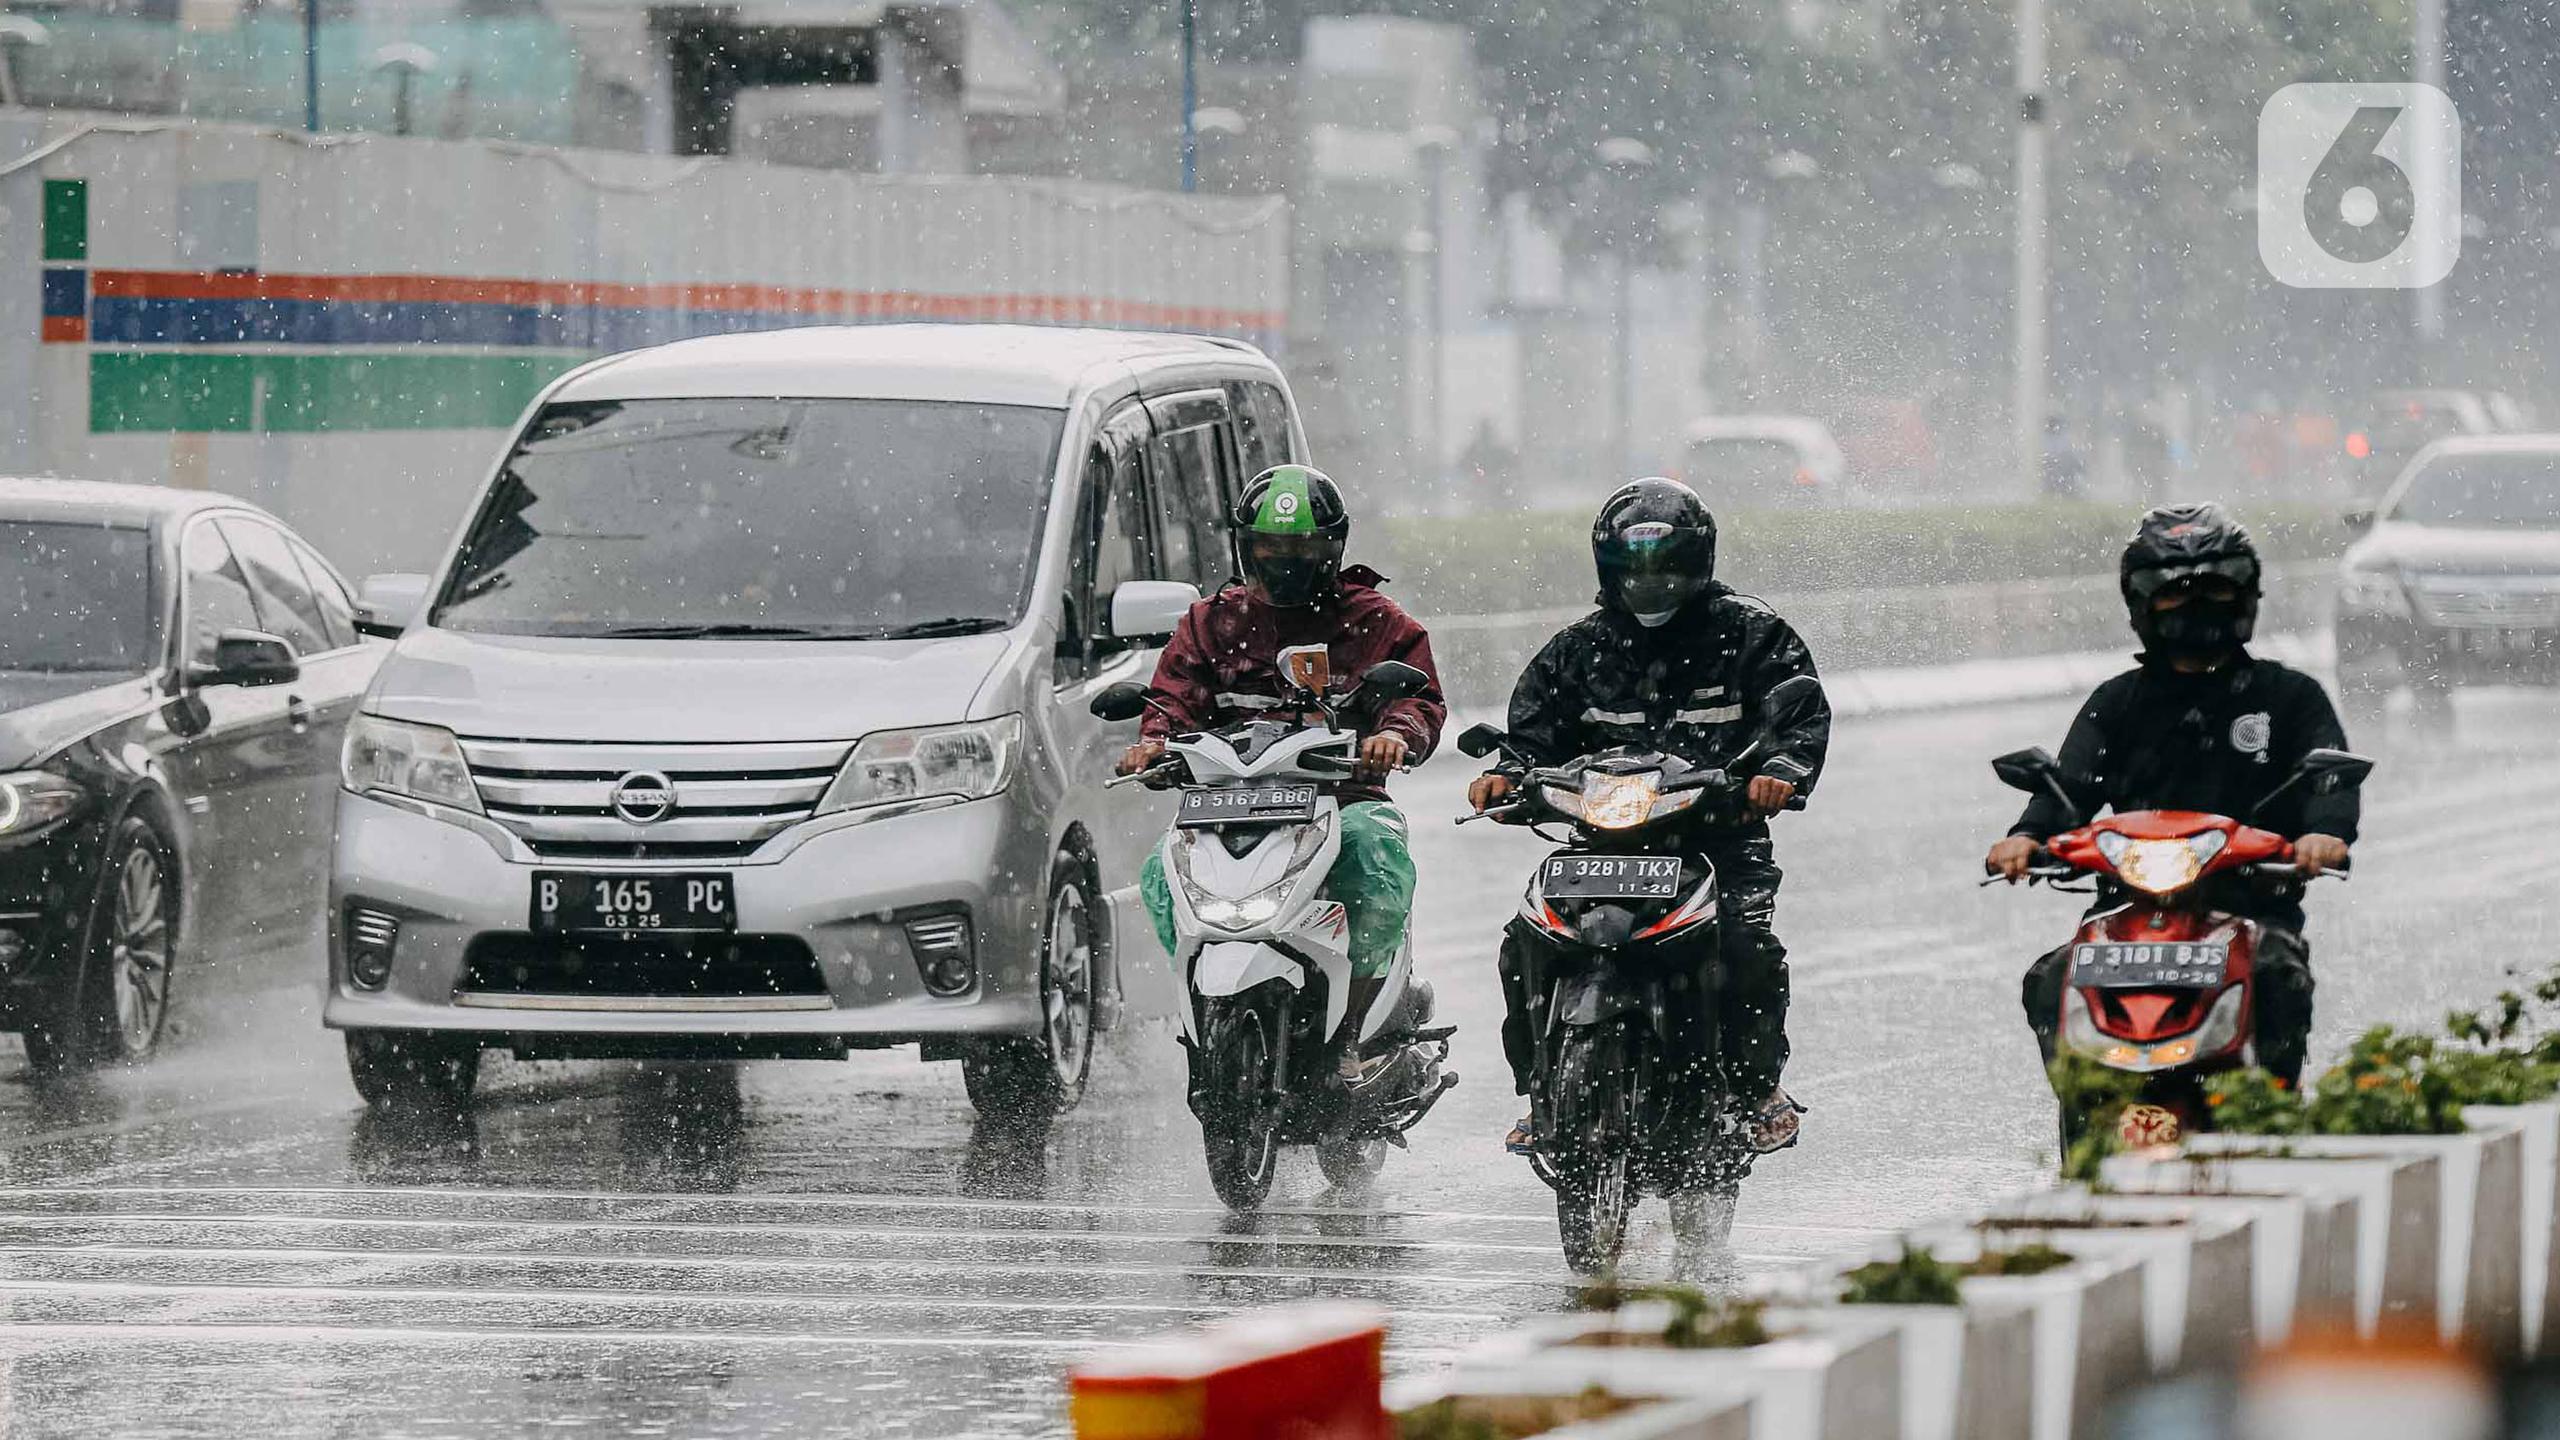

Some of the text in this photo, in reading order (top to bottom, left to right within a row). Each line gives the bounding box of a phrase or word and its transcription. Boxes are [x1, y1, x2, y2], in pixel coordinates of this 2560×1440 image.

[617, 792, 668, 801] NISSAN
[1190, 791, 1308, 808] B 5167 BBC
[1551, 860, 1677, 877] B 3281 TKX
[540, 879, 724, 912] B 165 PC
[2078, 947, 2095, 966] B
